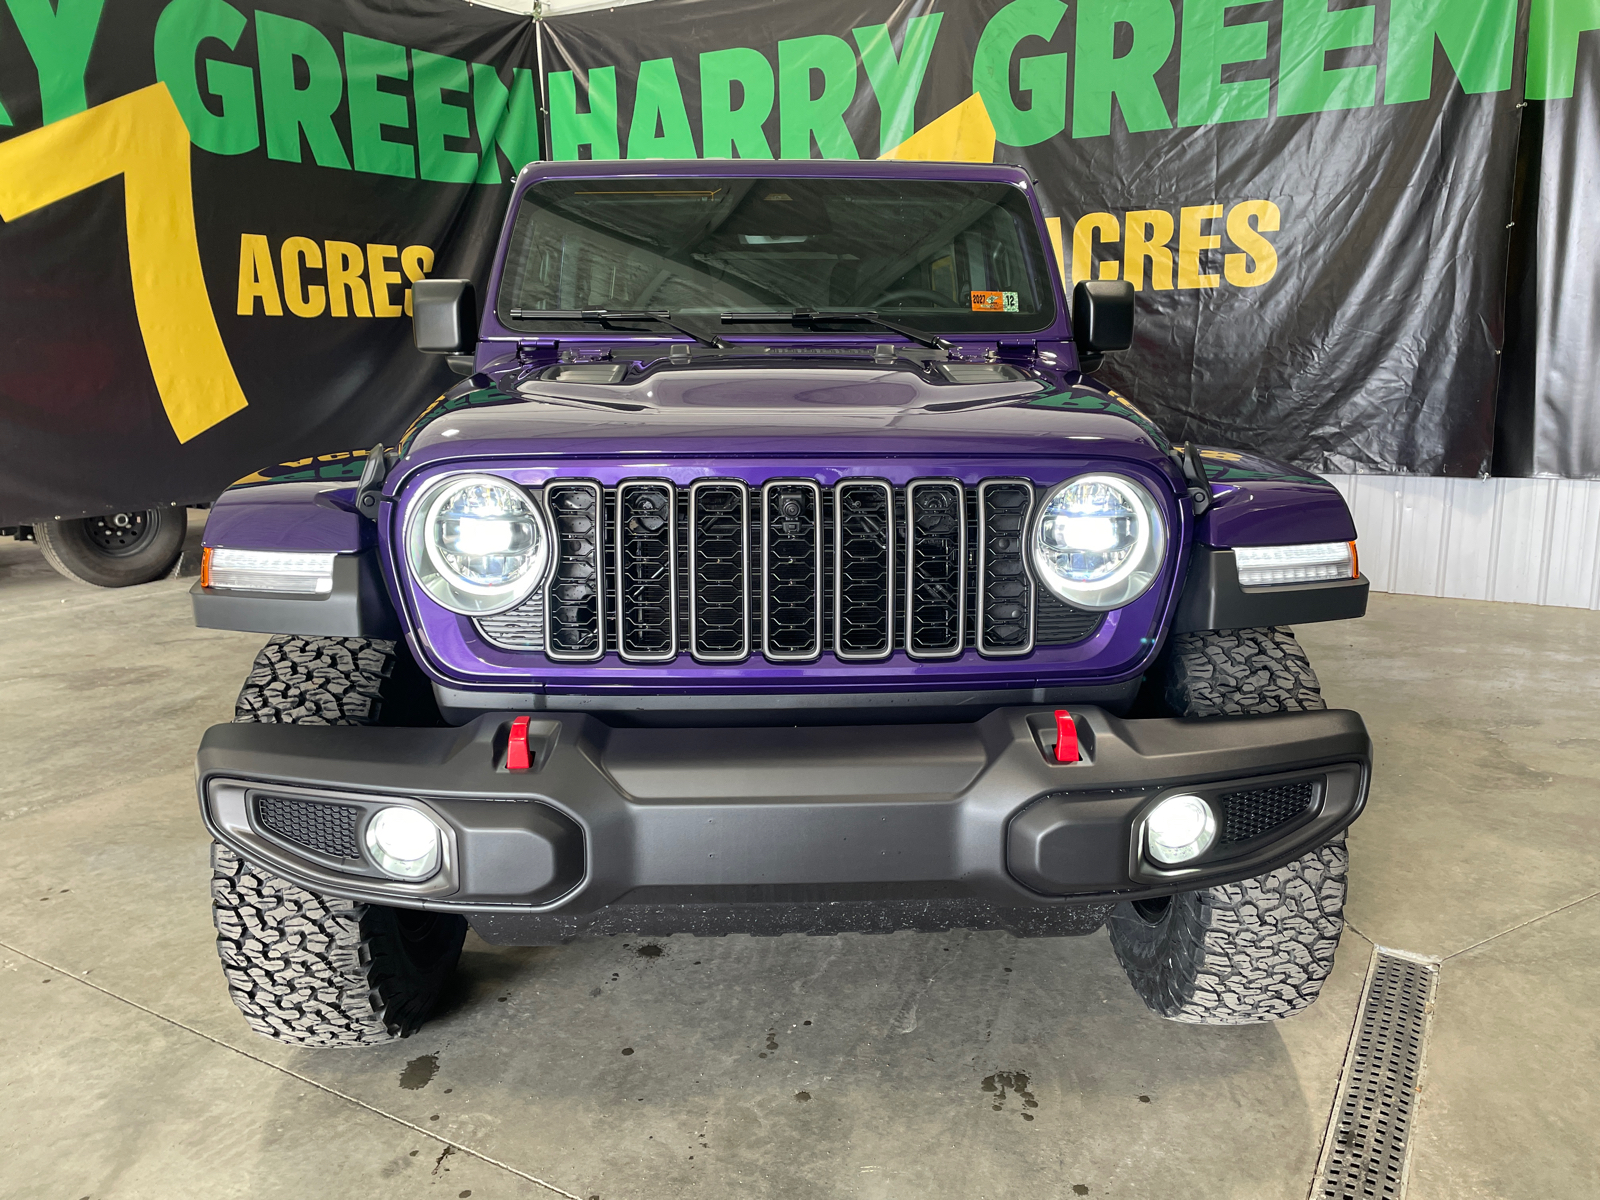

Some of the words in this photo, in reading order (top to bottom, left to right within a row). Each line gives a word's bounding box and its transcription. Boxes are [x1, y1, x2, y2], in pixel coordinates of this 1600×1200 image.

[153, 0, 540, 185] GREEN
[548, 12, 944, 161] HARRY
[972, 0, 1518, 147] GREEN
[237, 233, 435, 318] ACRES
[973, 294, 986, 304] 2027
[1005, 294, 1015, 306] 12
